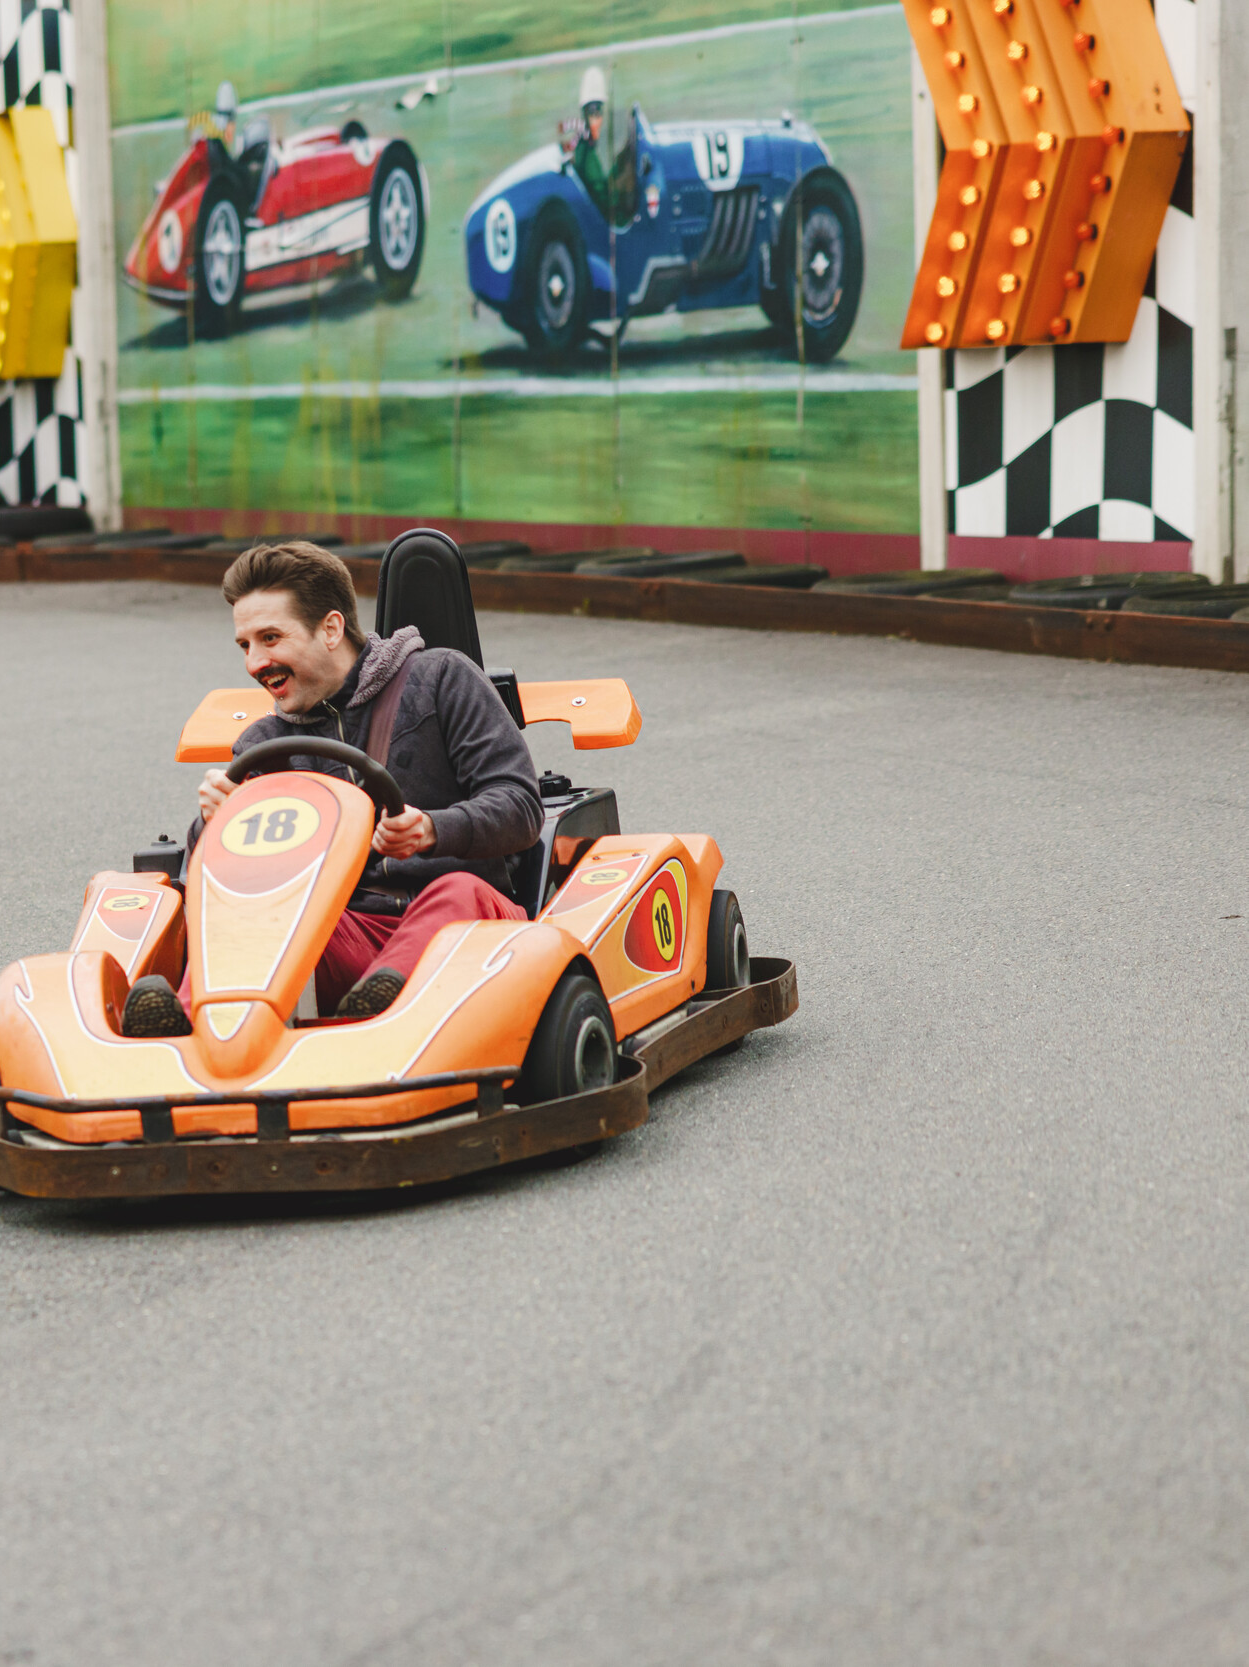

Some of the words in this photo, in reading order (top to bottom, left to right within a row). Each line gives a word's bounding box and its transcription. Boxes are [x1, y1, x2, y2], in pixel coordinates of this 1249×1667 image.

[703, 131, 730, 181] 19
[239, 808, 299, 846] 18
[588, 872, 619, 883] 18
[112, 896, 141, 909] 18
[654, 902, 672, 950] 18
